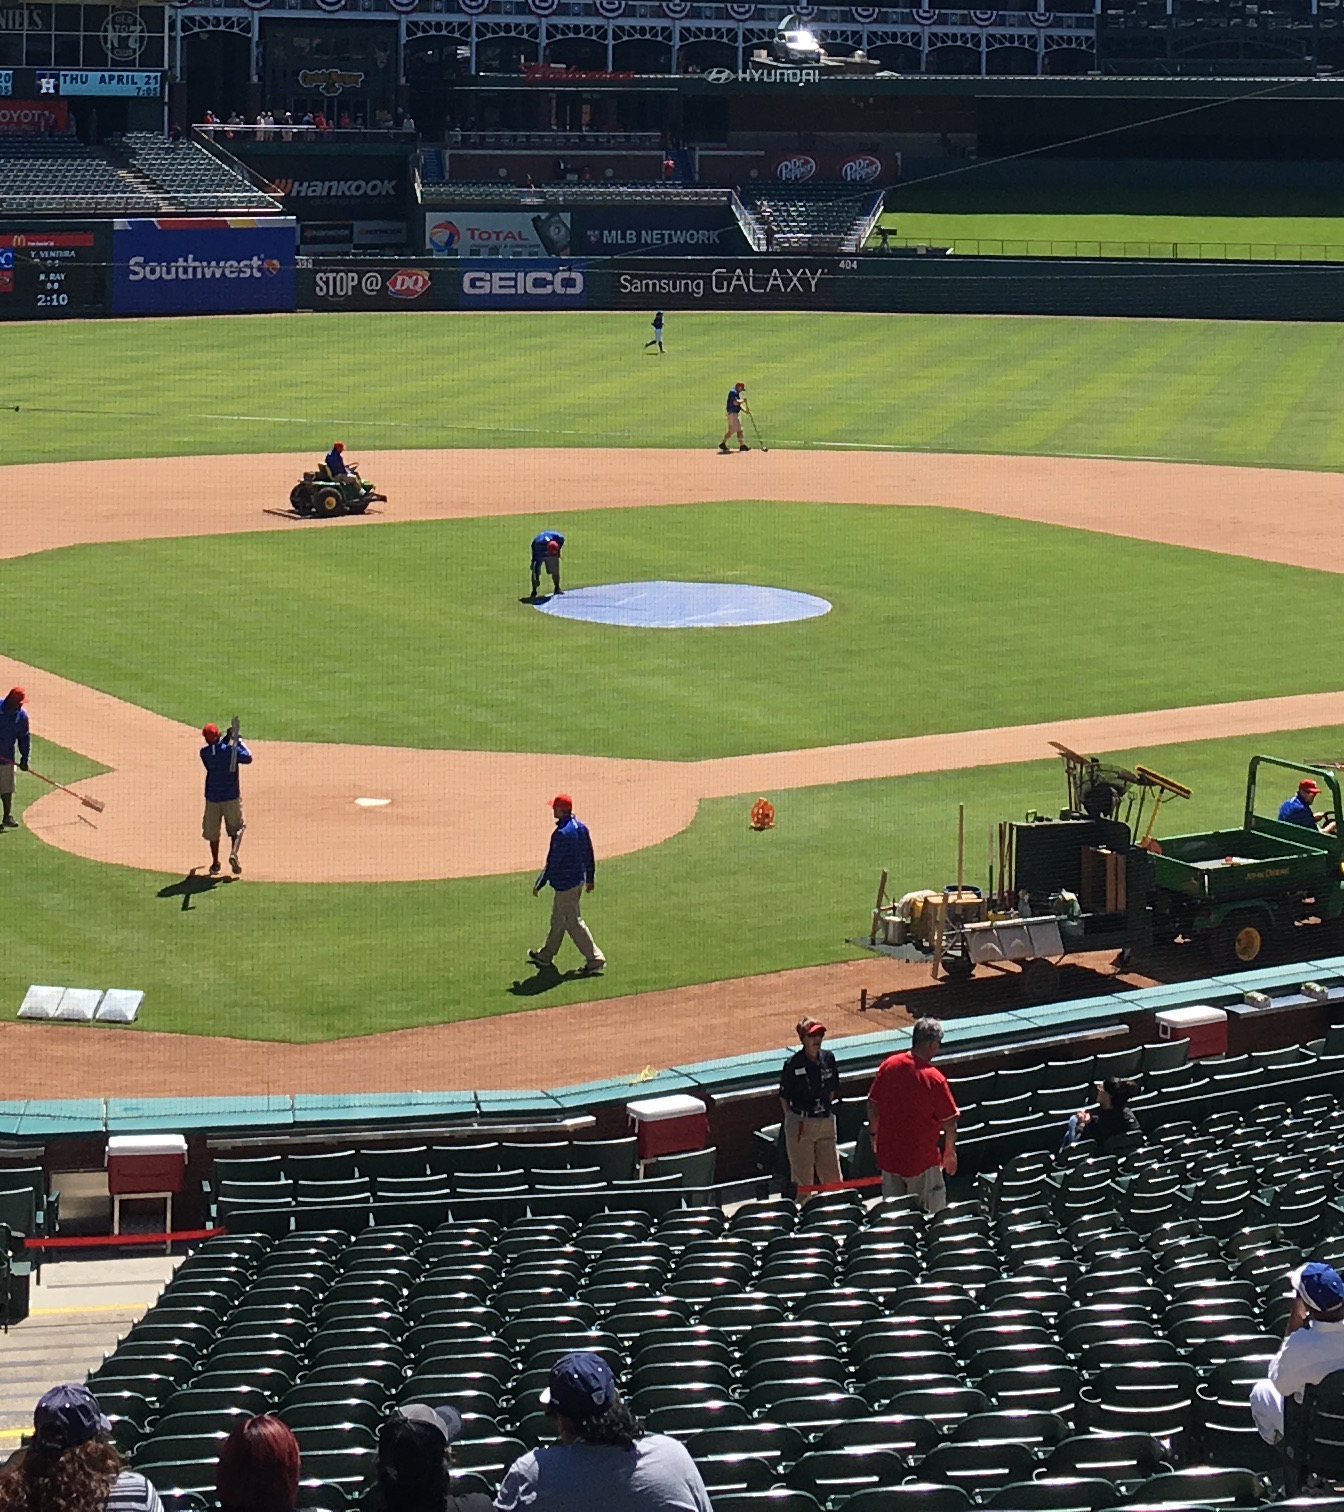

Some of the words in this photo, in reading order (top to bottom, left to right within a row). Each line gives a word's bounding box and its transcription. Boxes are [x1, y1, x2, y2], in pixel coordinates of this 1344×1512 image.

[61, 73, 89, 86] THU
[98, 74, 137, 87] APRIL
[738, 69, 819, 85] HYUNDAI
[465, 227, 529, 243] TOTAL
[603, 230, 637, 244] MLB
[640, 230, 720, 245] NETWORK
[128, 254, 265, 281] Southwest
[839, 260, 858, 270] 404
[315, 272, 358, 297] STOP
[361, 272, 382, 296] @
[395, 275, 424, 291] DQ
[462, 271, 584, 295] GEICO
[620, 275, 704, 298] Samsung
[712, 268, 823, 294] GALAXY
[37, 293, 69, 306] 2:10
